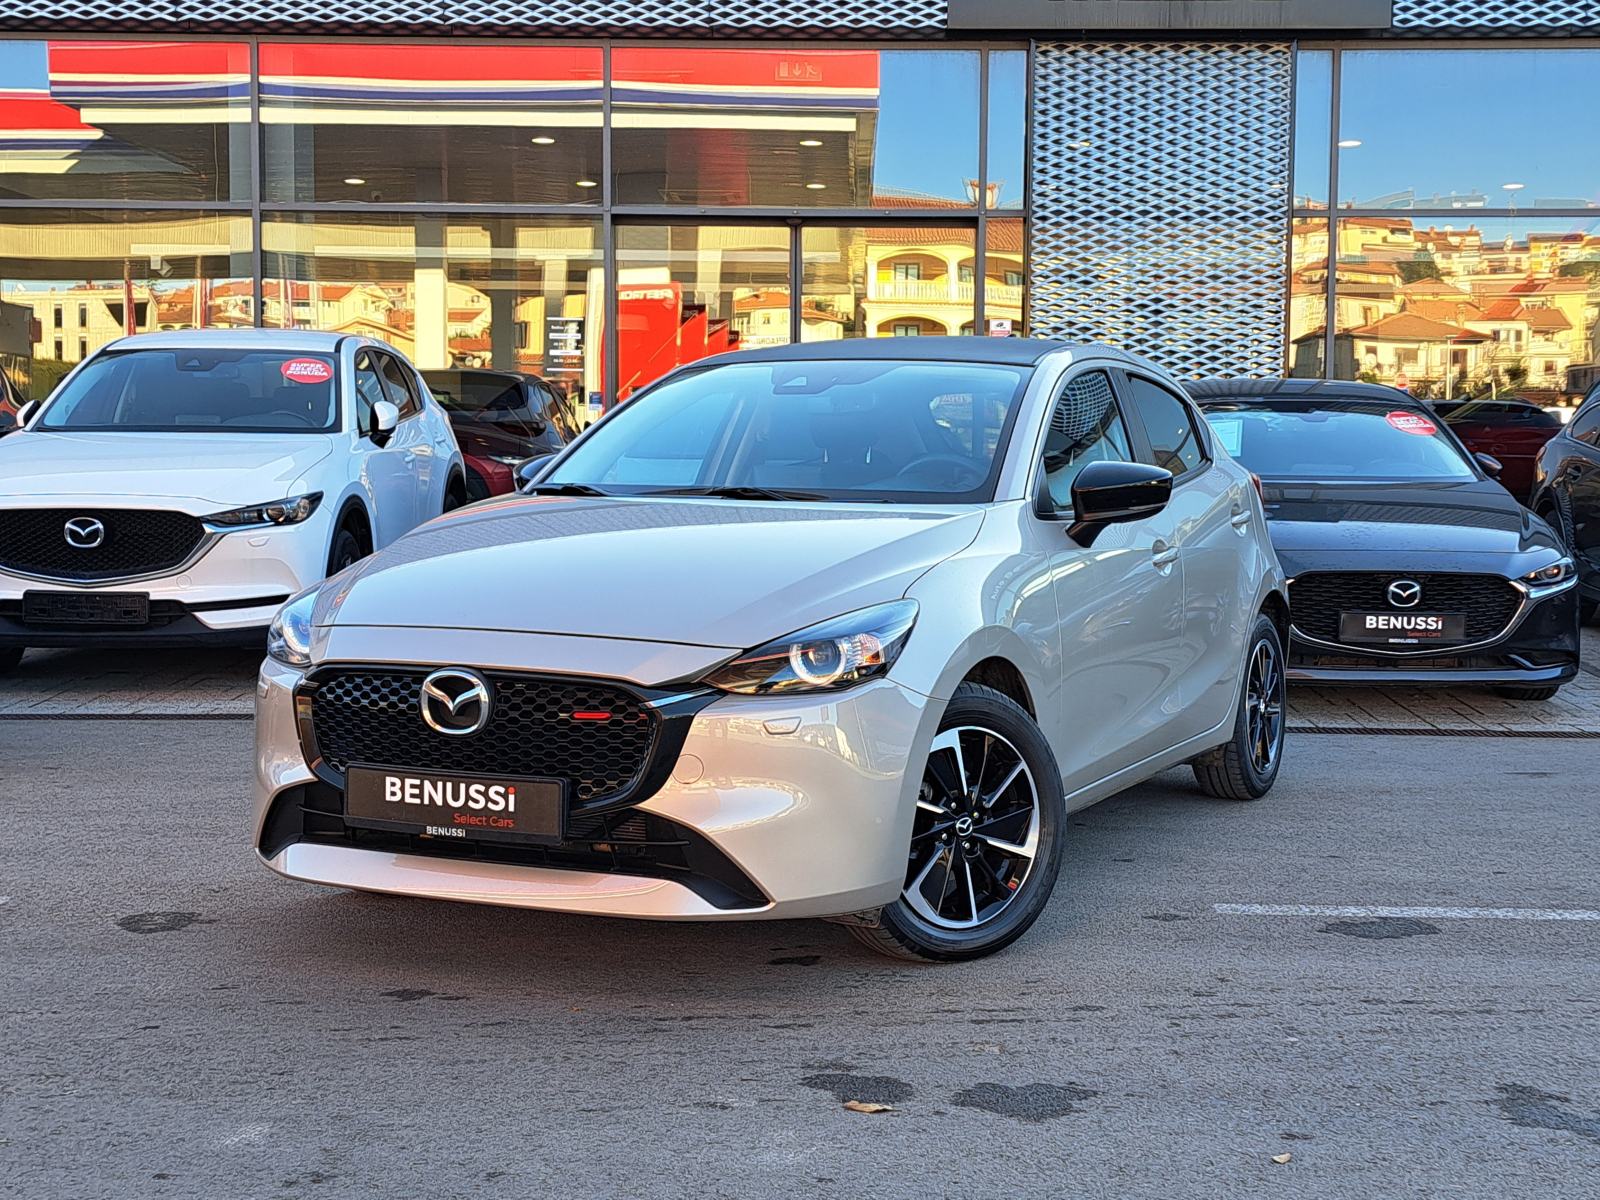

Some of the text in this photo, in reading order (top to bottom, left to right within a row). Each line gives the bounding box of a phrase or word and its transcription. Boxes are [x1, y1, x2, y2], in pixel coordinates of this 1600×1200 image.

[453, 812, 515, 828] Select Cars
[426, 825, 466, 838] BENUSSI
